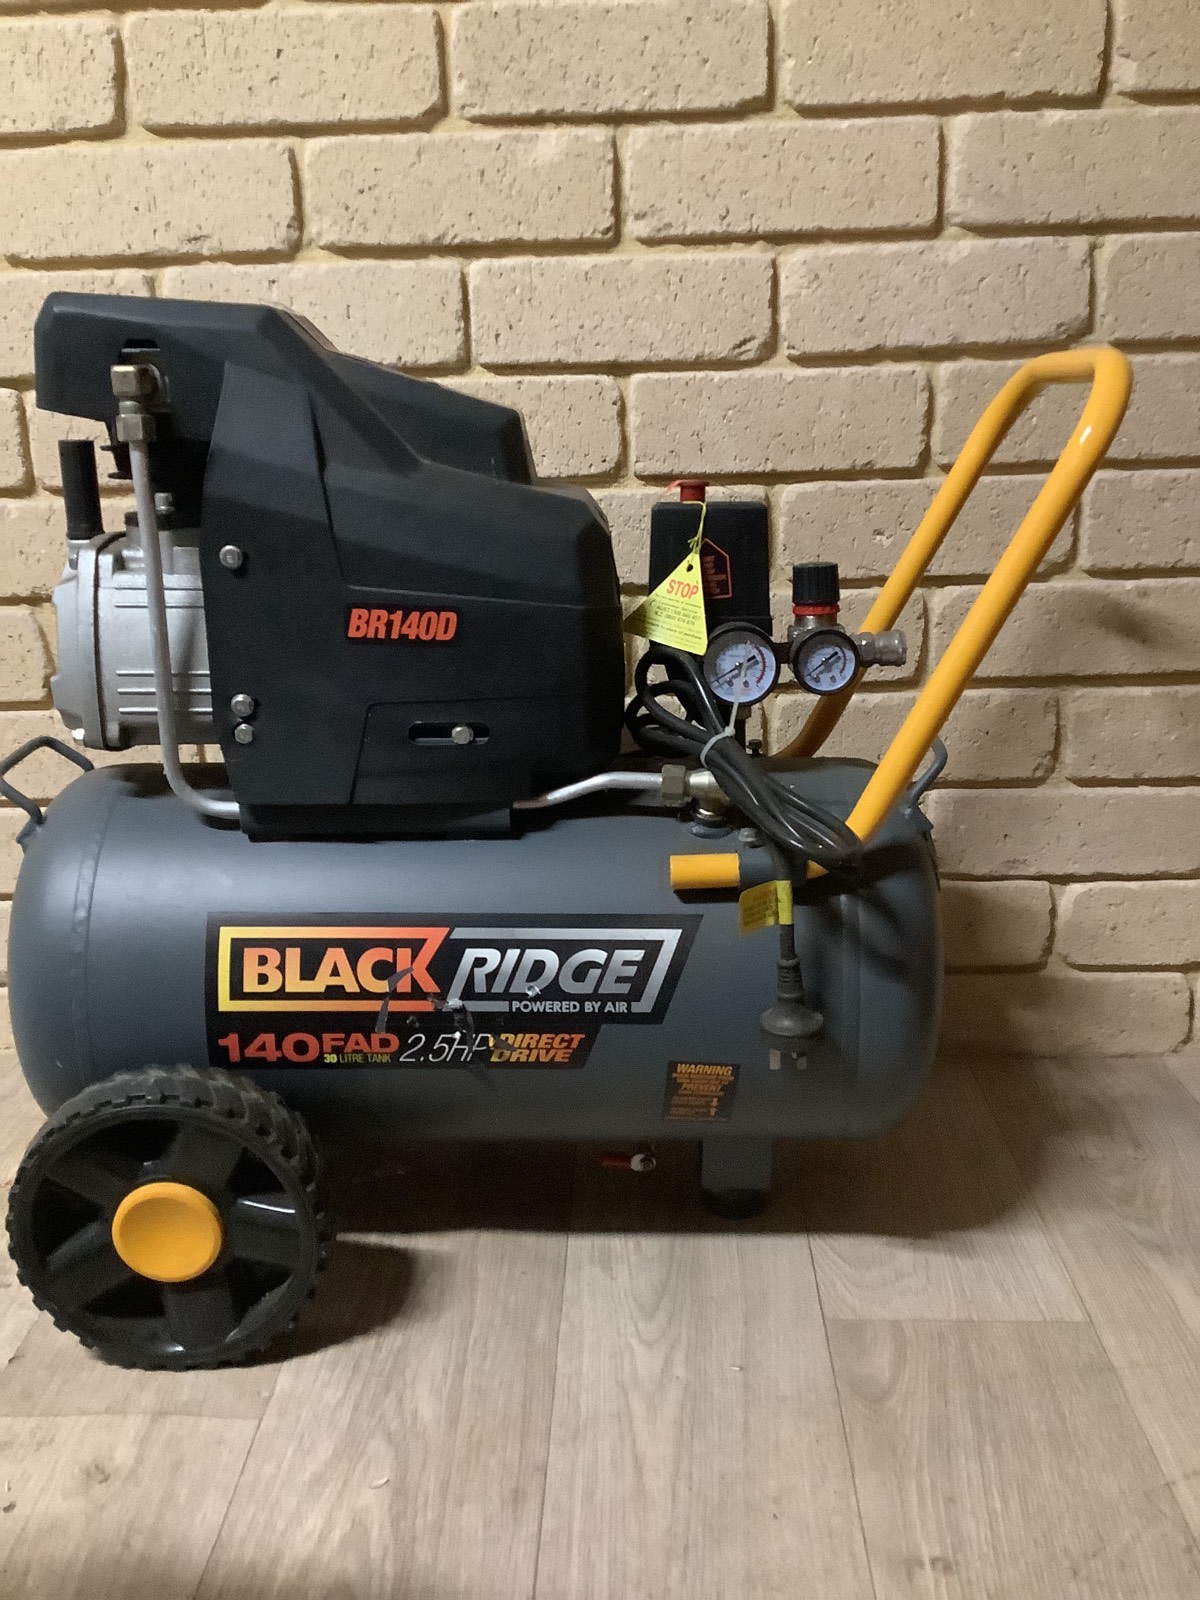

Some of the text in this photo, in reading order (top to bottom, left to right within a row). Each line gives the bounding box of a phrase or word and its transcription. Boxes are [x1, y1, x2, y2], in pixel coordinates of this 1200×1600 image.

[666, 579, 699, 599] STOP
[347, 608, 458, 640] BR140D
[242, 946, 646, 1000] BLACK RIDGE
[512, 1000, 628, 1014] POWERED BY AIR
[323, 1053, 392, 1064] 30 LITRE TANK
[489, 1048, 574, 1063] DRIVE
[676, 1063, 733, 1076] WARNING
